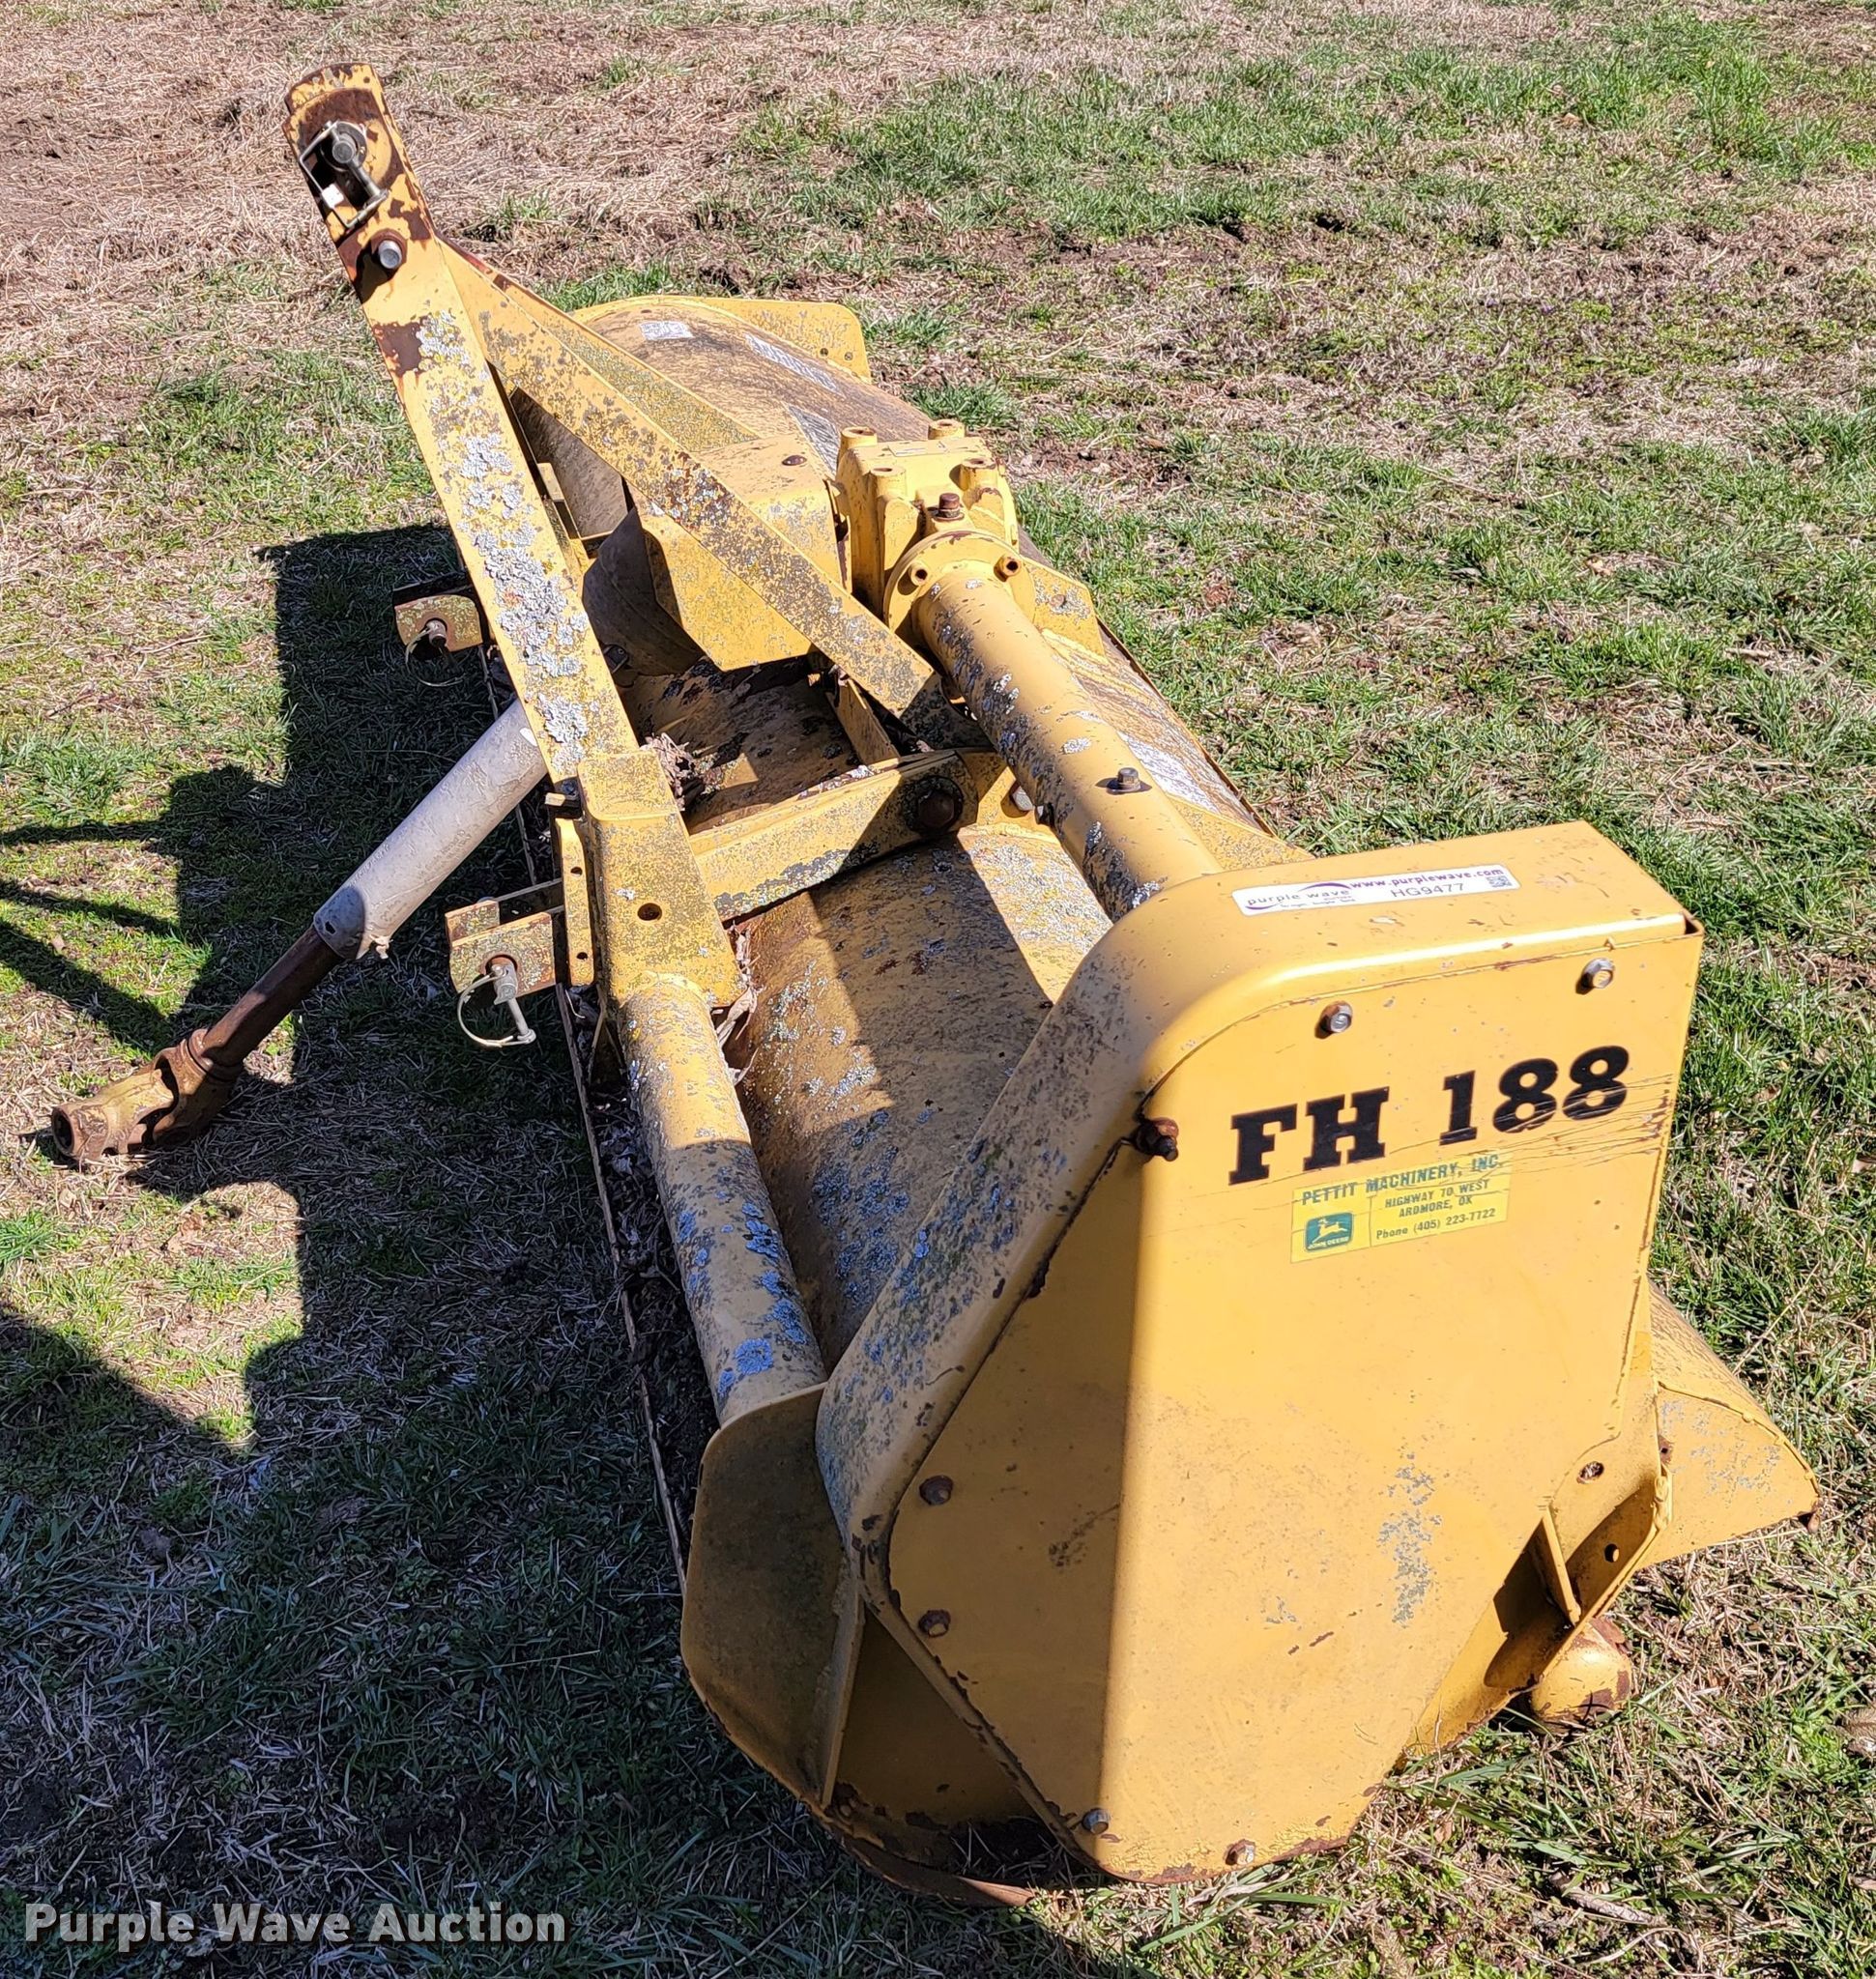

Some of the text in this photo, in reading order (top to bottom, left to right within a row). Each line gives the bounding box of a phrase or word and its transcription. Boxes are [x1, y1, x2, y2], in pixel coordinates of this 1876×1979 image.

[1351, 869, 1504, 888] www.purplewave.com
[1391, 882, 1464, 898] HG9477
[1247, 893, 1301, 905] purple
[1307, 889, 1350, 899] wave
[1228, 1046, 1630, 1186] FH 188
[1302, 1181, 1358, 1206] PETTIT
[1366, 1162, 1463, 1193] MACHINERY,
[1385, 1178, 1490, 1208] HIGHWAY 70 WEST
[1399, 1194, 1473, 1218] ARDMORE, OK
[1376, 1207, 1496, 1240] Phone (405) 223-7722
